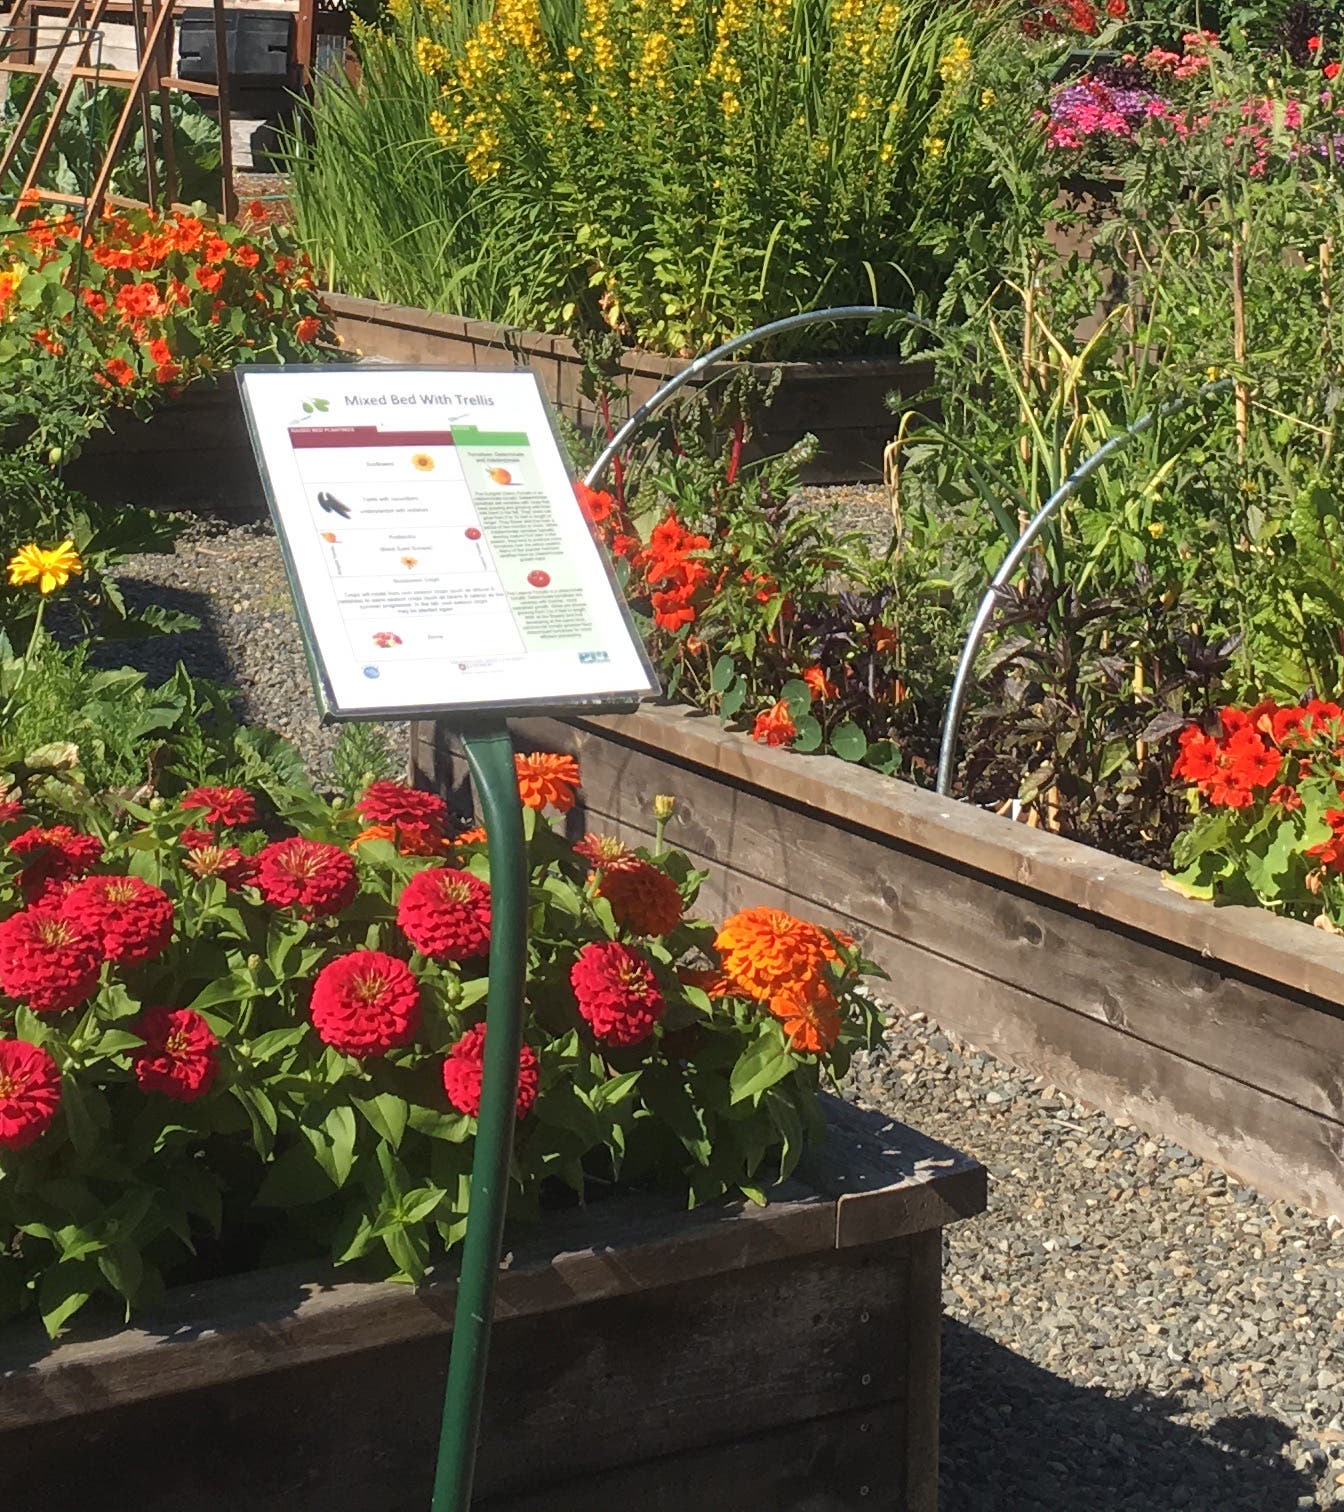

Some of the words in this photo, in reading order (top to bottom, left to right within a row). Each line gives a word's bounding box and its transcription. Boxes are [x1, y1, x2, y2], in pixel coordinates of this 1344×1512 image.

[344, 394, 387, 407] Mixed
[391, 393, 416, 406] Bed
[421, 393, 452, 406] With
[455, 393, 495, 406] Trellis
